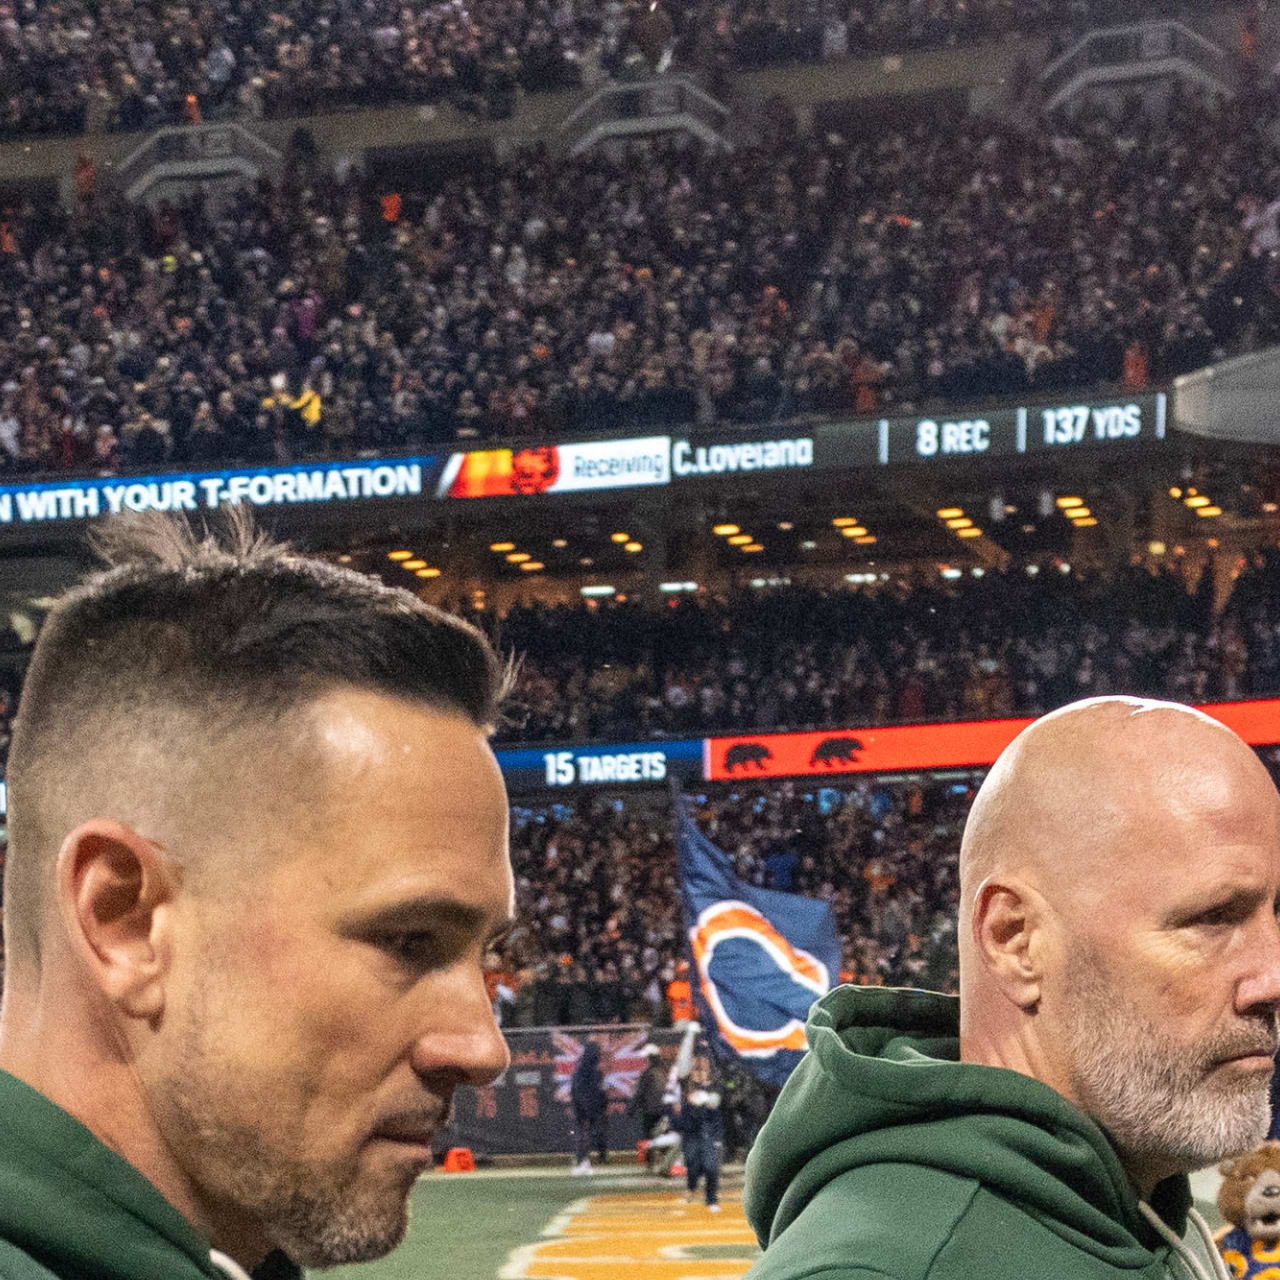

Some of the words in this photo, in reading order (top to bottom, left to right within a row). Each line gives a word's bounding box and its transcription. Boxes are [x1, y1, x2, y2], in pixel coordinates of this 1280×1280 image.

[917, 419, 938, 456] 8
[941, 420, 990, 453] REC
[1042, 405, 1090, 444] 137
[1092, 404, 1142, 439] YDS
[16, 487, 100, 522] WITH
[103, 480, 198, 514] YOUR
[200, 464, 422, 508] T-FORMATION
[543, 752, 576, 786] 15
[576, 751, 667, 784] TARGETS
